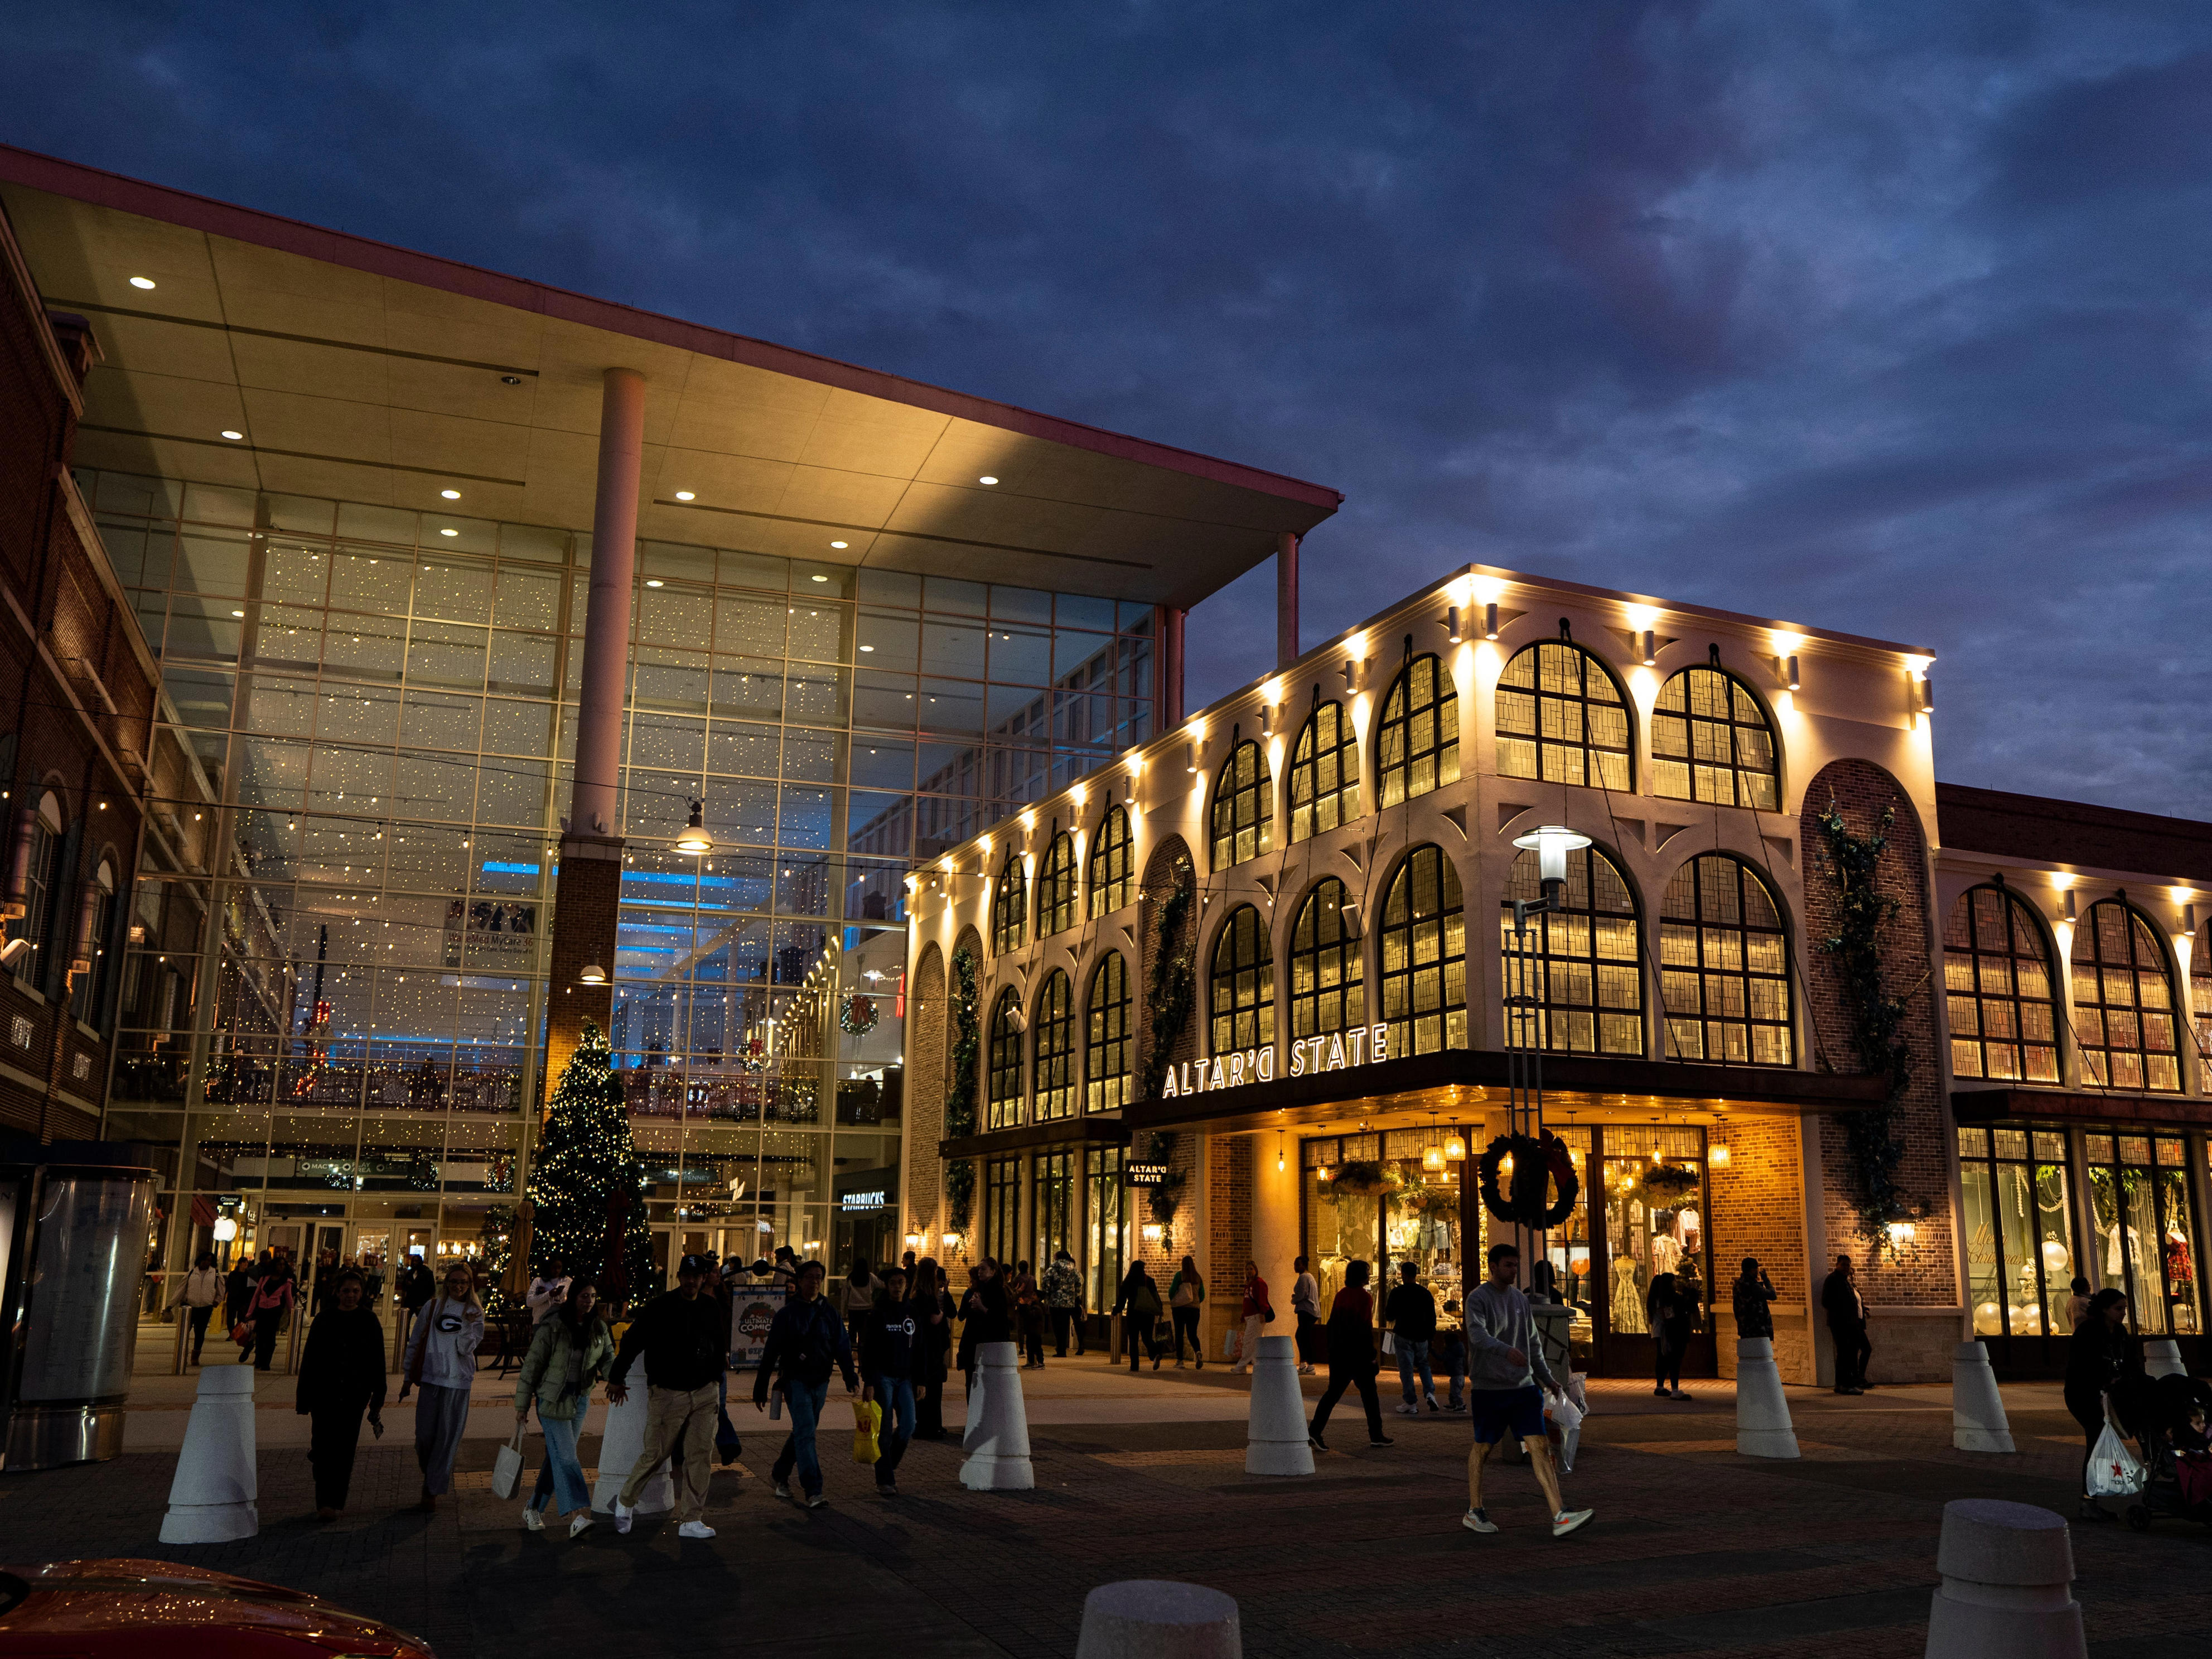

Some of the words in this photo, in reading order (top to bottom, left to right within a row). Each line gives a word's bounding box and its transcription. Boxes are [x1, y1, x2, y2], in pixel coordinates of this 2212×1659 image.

[448, 932, 489, 944] WaeMed
[1162, 1045, 1274, 1099] ALTAR'D
[1290, 1023, 1388, 1078] STATE
[842, 1190, 885, 1211] STARBUCKS
[435, 1314, 462, 1334] G
